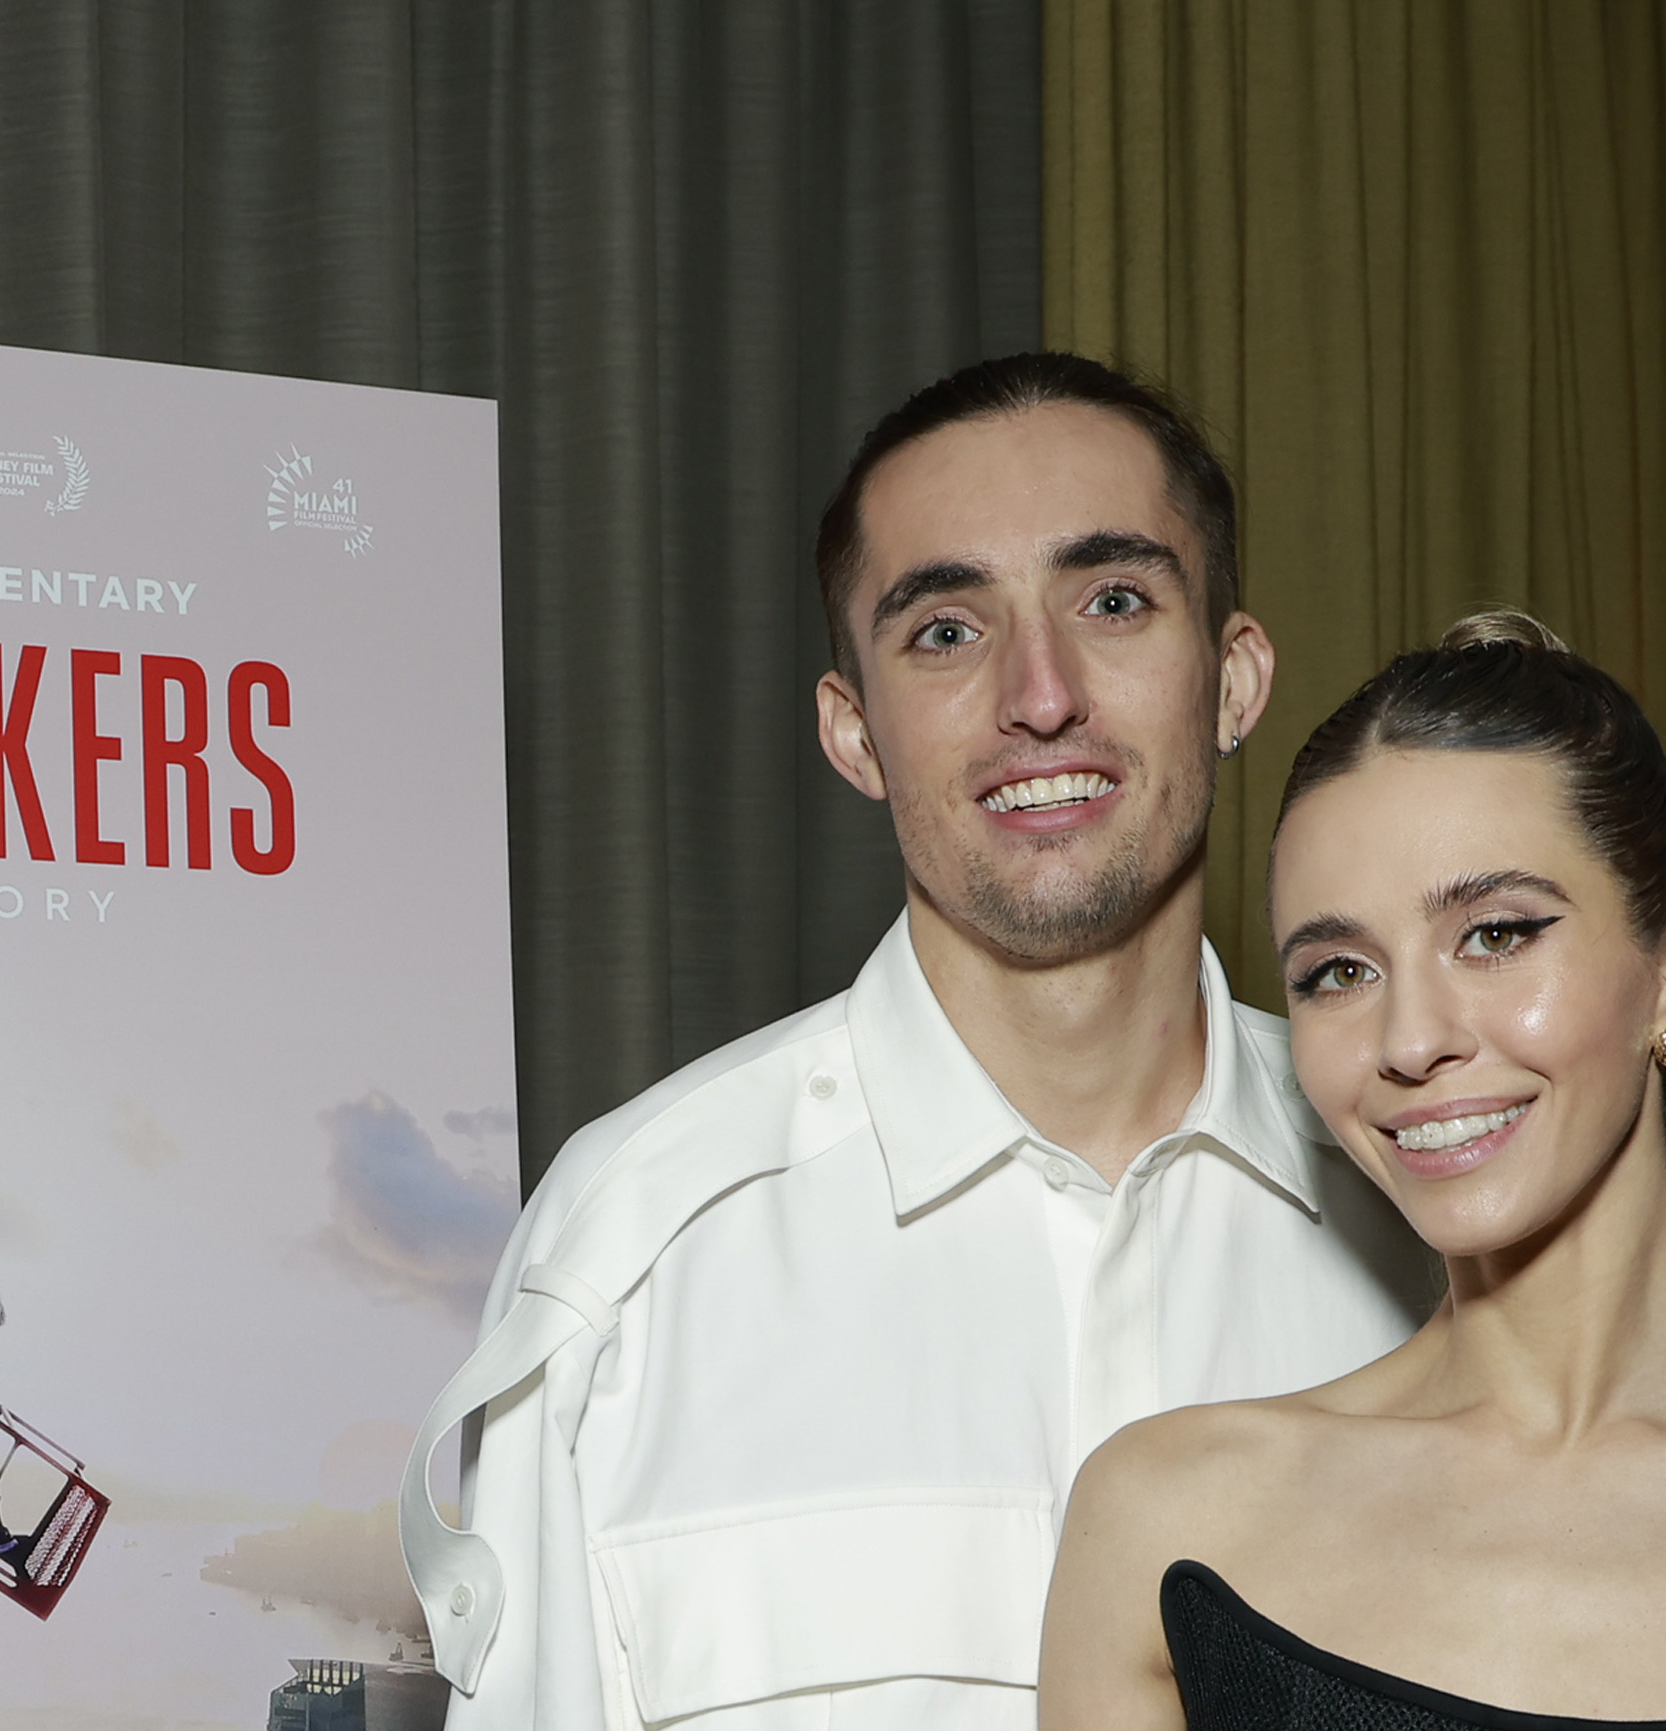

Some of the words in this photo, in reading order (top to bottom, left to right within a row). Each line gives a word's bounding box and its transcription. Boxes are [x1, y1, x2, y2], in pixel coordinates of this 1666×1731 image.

[23, 462, 53, 475] FILM
[333, 478, 352, 494] 41
[293, 490, 357, 515] MIAMI
[293, 510, 315, 520] FILM
[317, 512, 357, 524] FESTIVAL
